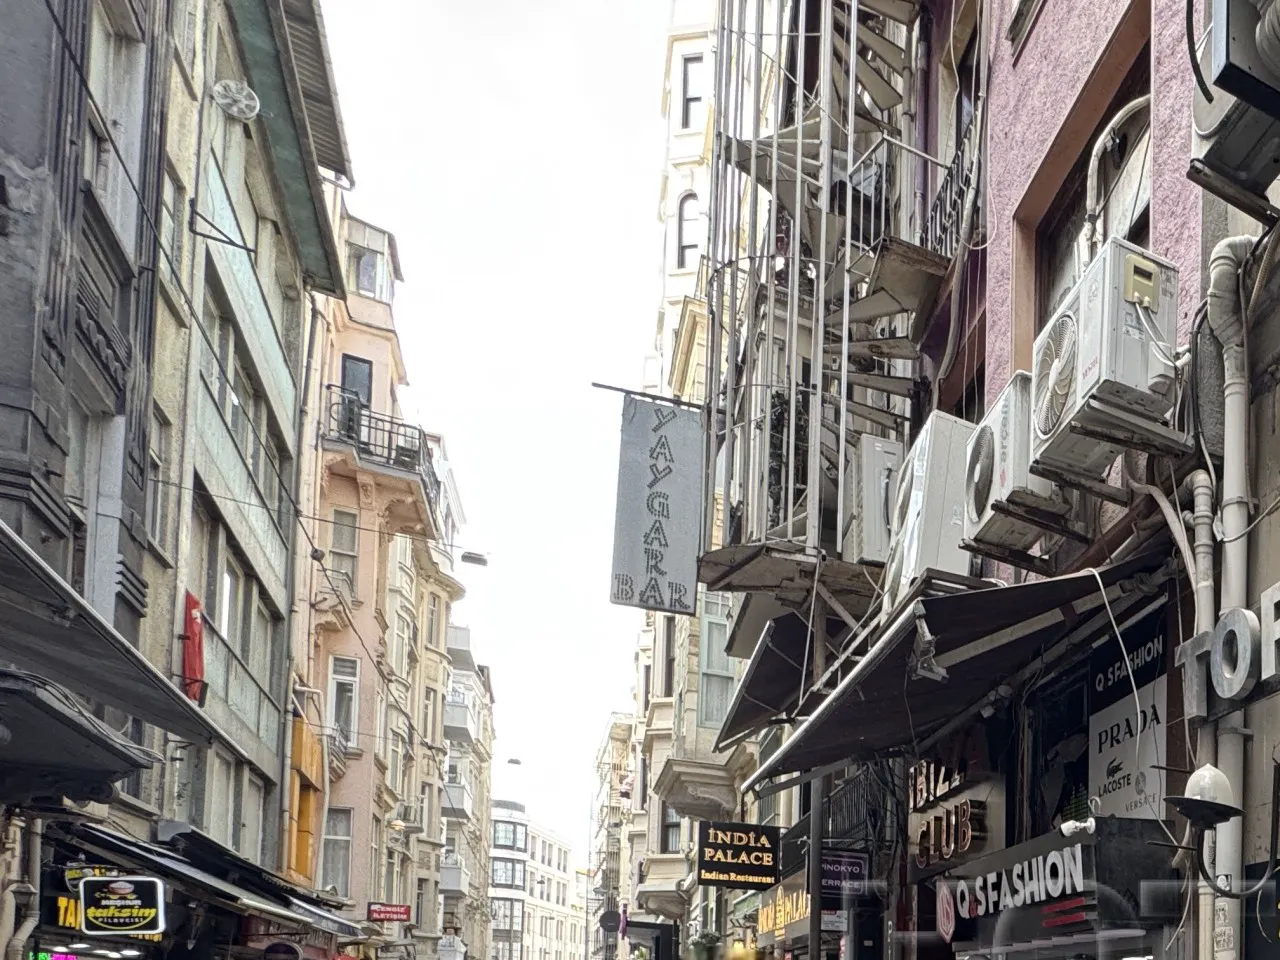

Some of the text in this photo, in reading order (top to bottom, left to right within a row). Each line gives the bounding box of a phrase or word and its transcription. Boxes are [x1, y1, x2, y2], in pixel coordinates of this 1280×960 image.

[613, 573, 691, 611] BAR
[1098, 703, 1162, 755] PRADA
[1098, 773, 1132, 798] LACOSTE
[915, 799, 972, 869] CLUB
[704, 848, 774, 867] PALACE
[731, 872, 775, 885] Restaurant
[86, 906, 157, 917] taksim
